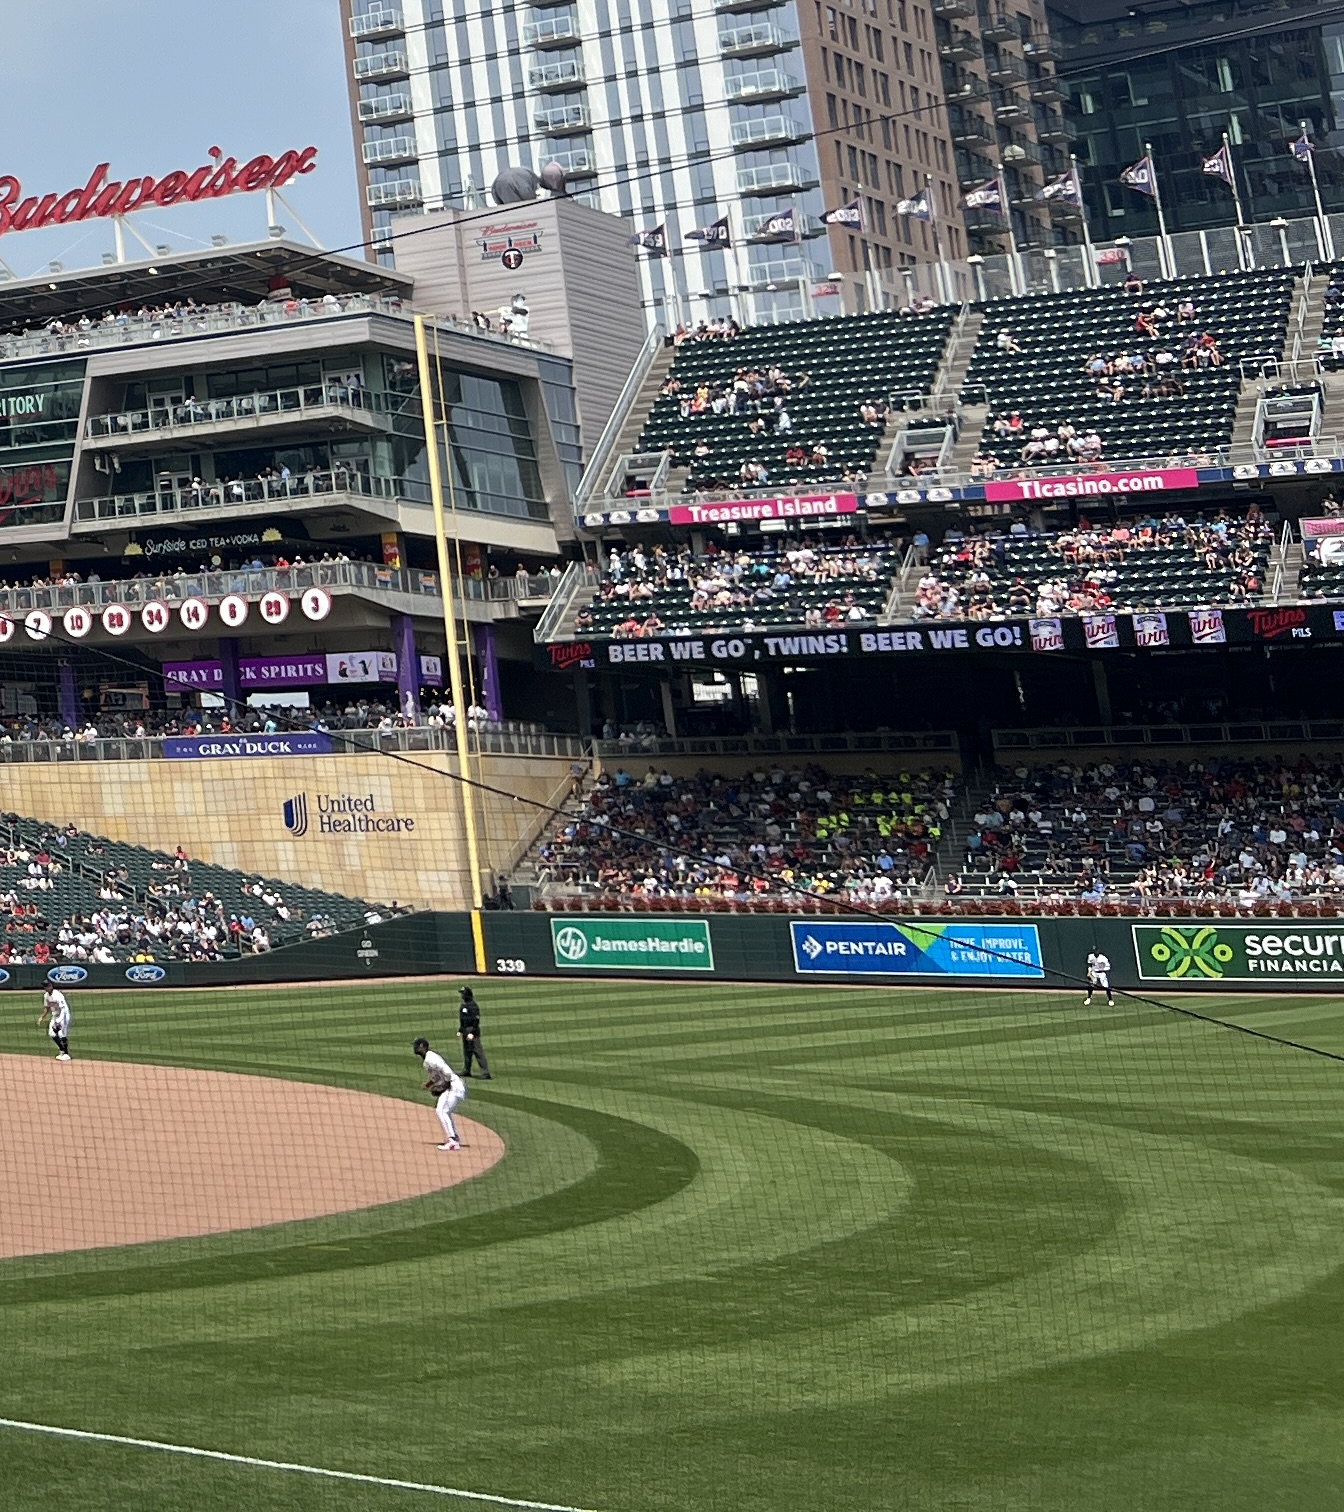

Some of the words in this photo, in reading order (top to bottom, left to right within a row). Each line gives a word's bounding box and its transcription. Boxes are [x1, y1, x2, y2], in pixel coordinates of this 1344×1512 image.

[1016, 472, 1163, 500] TIcasino.com
[688, 503, 772, 523] Treasure
[777, 496, 838, 517] Island
[144, 538, 186, 556] Surfside
[189, 538, 208, 550] ICED
[310, 596, 319, 613] 3
[70, 614, 83, 631] 10
[146, 609, 163, 625] 34
[186, 606, 200, 623] 14
[1247, 606, 1307, 638] Twins
[1292, 626, 1312, 638] PILS
[608, 643, 665, 662] BEER
[669, 641, 706, 660] WE
[764, 634, 849, 656] TWINS!
[859, 630, 924, 652] BEER
[927, 629, 970, 649] WE
[975, 626, 1023, 648] GO!
[547, 641, 592, 669] Twins
[167, 668, 207, 684] GRAY
[261, 661, 325, 679] SPIRITS
[198, 743, 242, 756] GRAY
[245, 741, 292, 754] DUCK
[317, 793, 375, 813] United
[319, 814, 415, 833] Healthcare
[591, 936, 705, 953] JamesHardie
[825, 939, 906, 956] PENTAIR
[496, 959, 526, 973] 339
[55, 968, 80, 982] Ford
